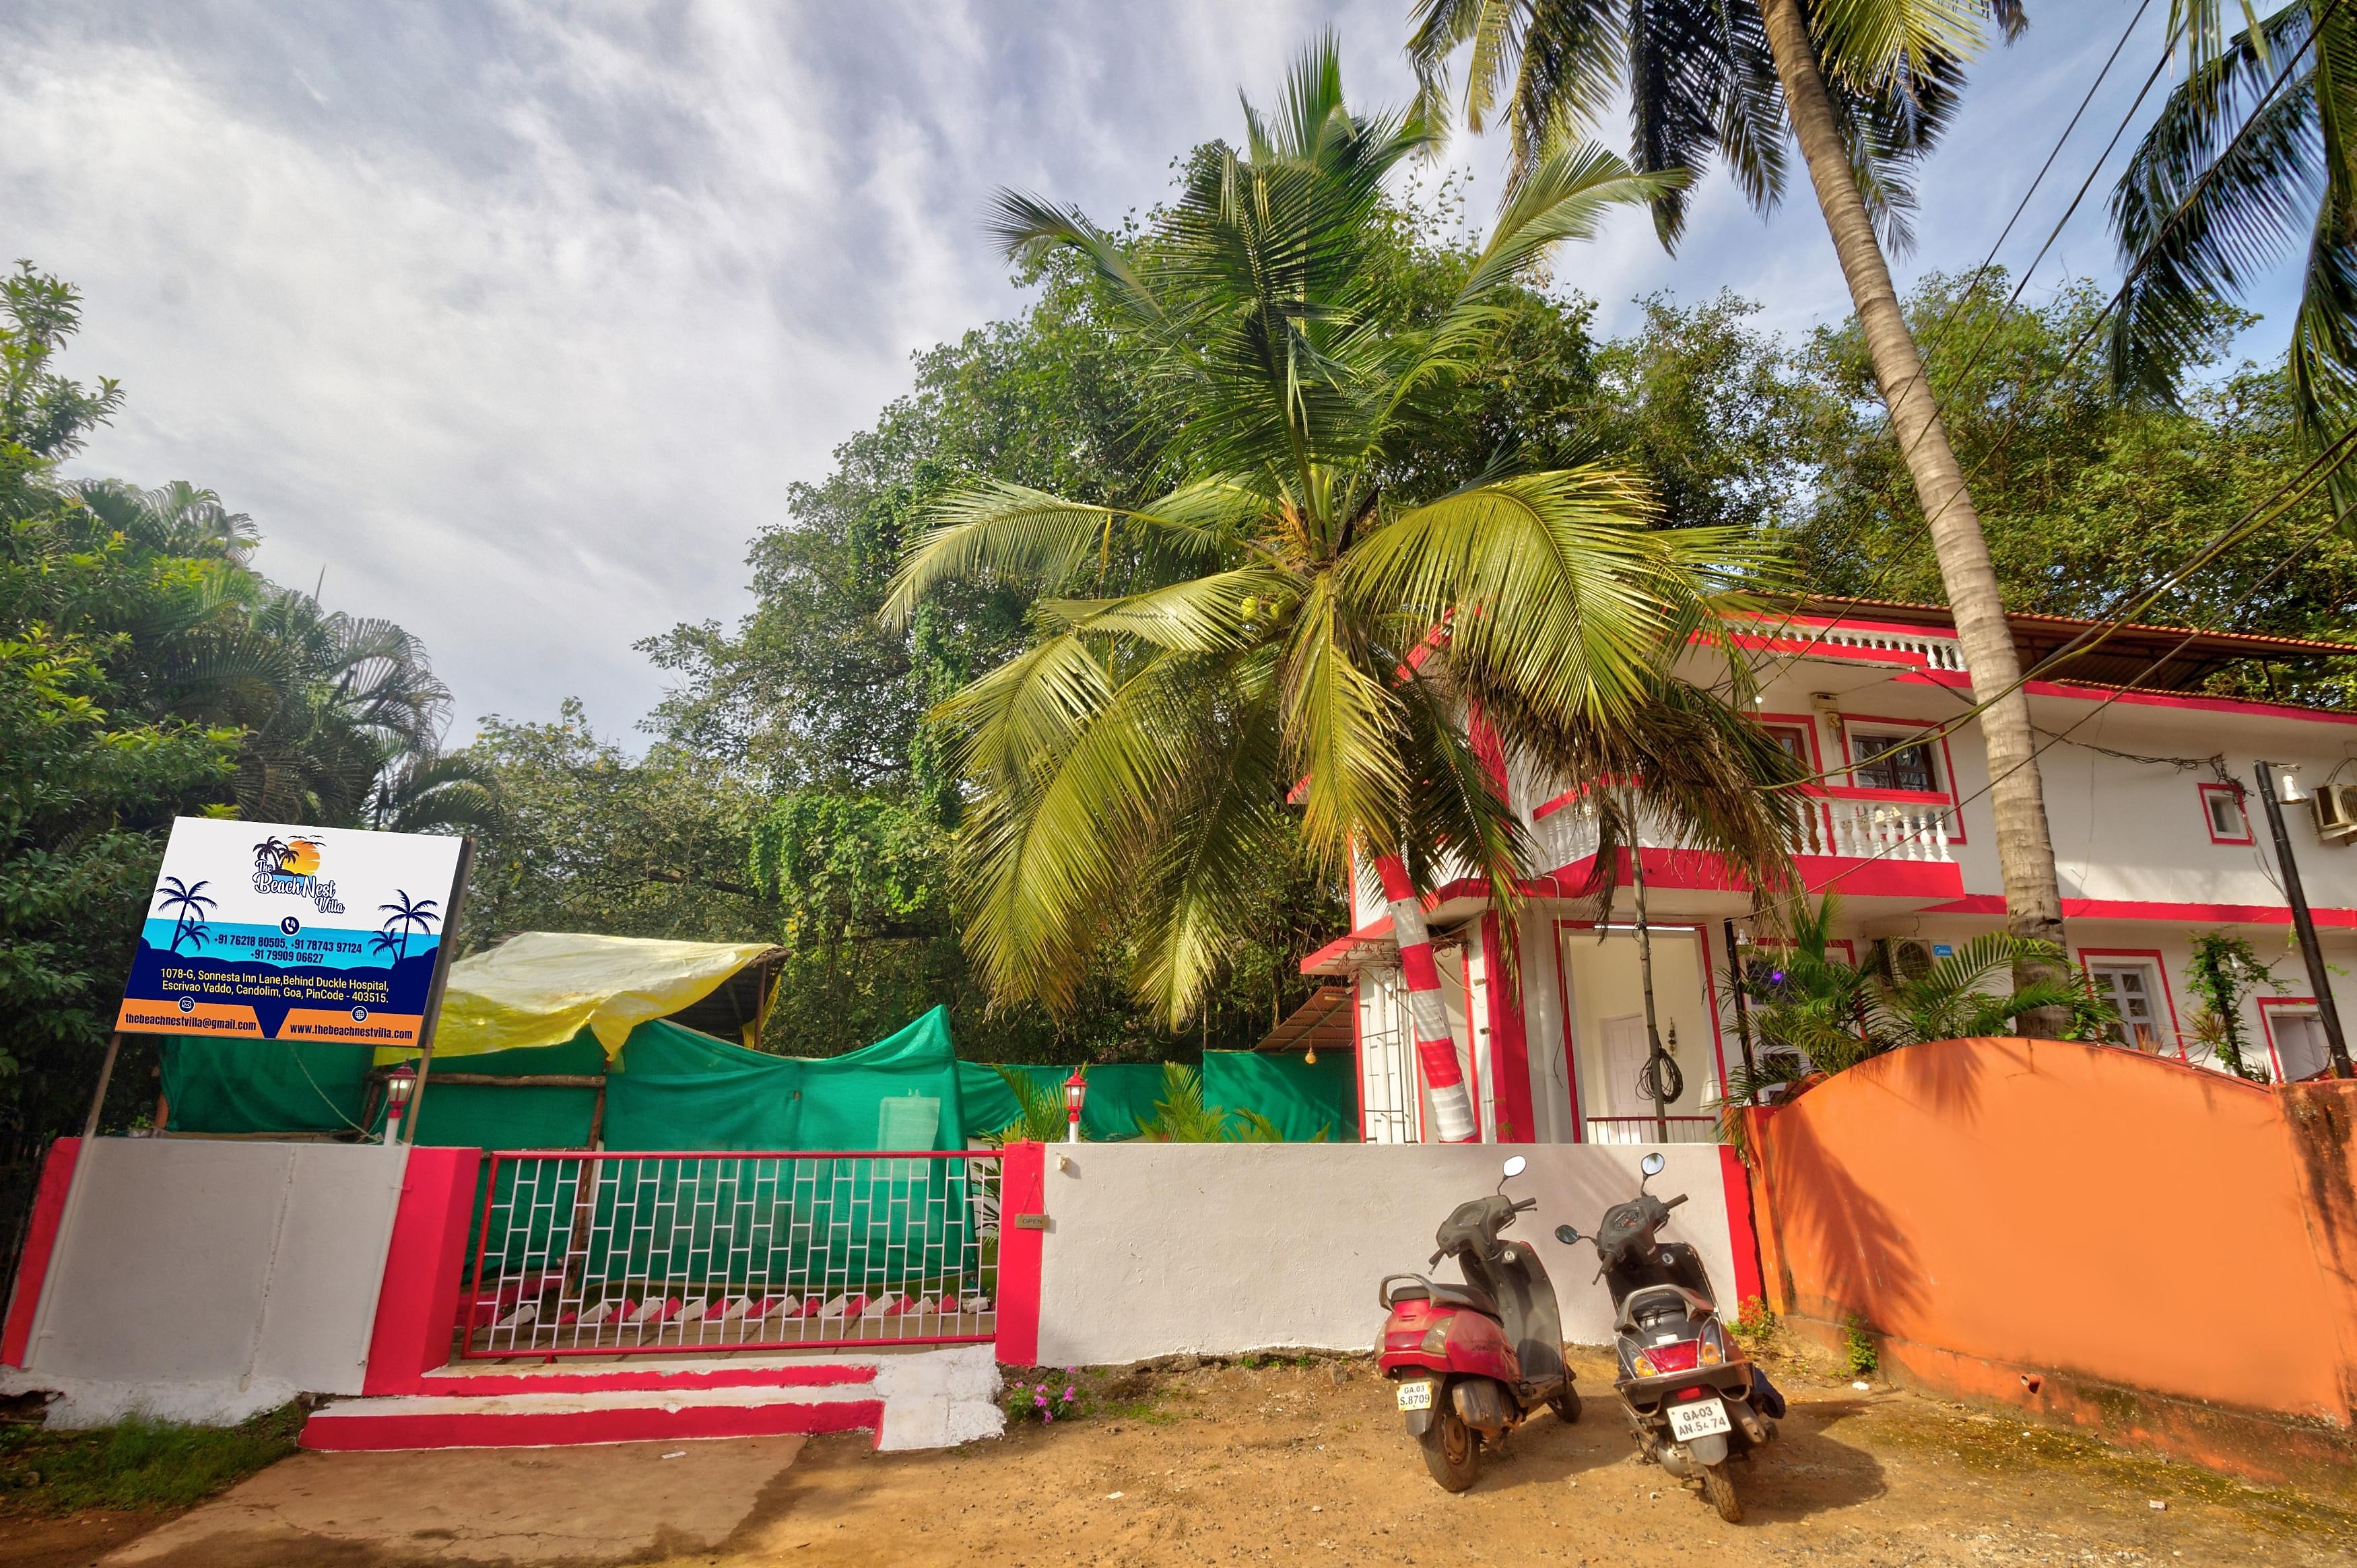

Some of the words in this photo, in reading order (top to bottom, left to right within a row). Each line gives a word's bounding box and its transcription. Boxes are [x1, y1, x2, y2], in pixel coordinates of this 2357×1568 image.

[255, 858, 273, 873] The
[253, 872, 302, 894] Beach
[301, 875, 336, 898] Nest
[314, 896, 345, 914] Villa
[214, 934, 228, 945] +91
[230, 935, 256, 947] 76218
[258, 936, 288, 950] 80505,
[291, 939, 304, 950] +91
[306, 940, 334, 952] 78743
[337, 942, 362, 954] 97124
[251, 949, 264, 959] +91
[267, 950, 294, 961] 79909
[296, 951, 324, 964] 06627
[161, 968, 196, 981] 1078-G,
[198, 970, 240, 982] Sonnesta
[242, 973, 257, 983] Inn
[316, 977, 347, 988] Duckle
[349, 979, 389, 992] Hospital,
[162, 980, 201, 992] Escrivao
[203, 982, 234, 996] Vaddo,
[236, 984, 281, 998] Candolim,
[284, 987, 304, 1000] Goa,
[306, 988, 344, 1000] PinCode
[352, 991, 389, 1003] 403515.
[125, 1013, 257, 1031] thebeachnestvilla@gmail.com
[290, 1024, 413, 1039] www.thebeachnestvilla.com
[1400, 1394, 1430, 1406] S.8709
